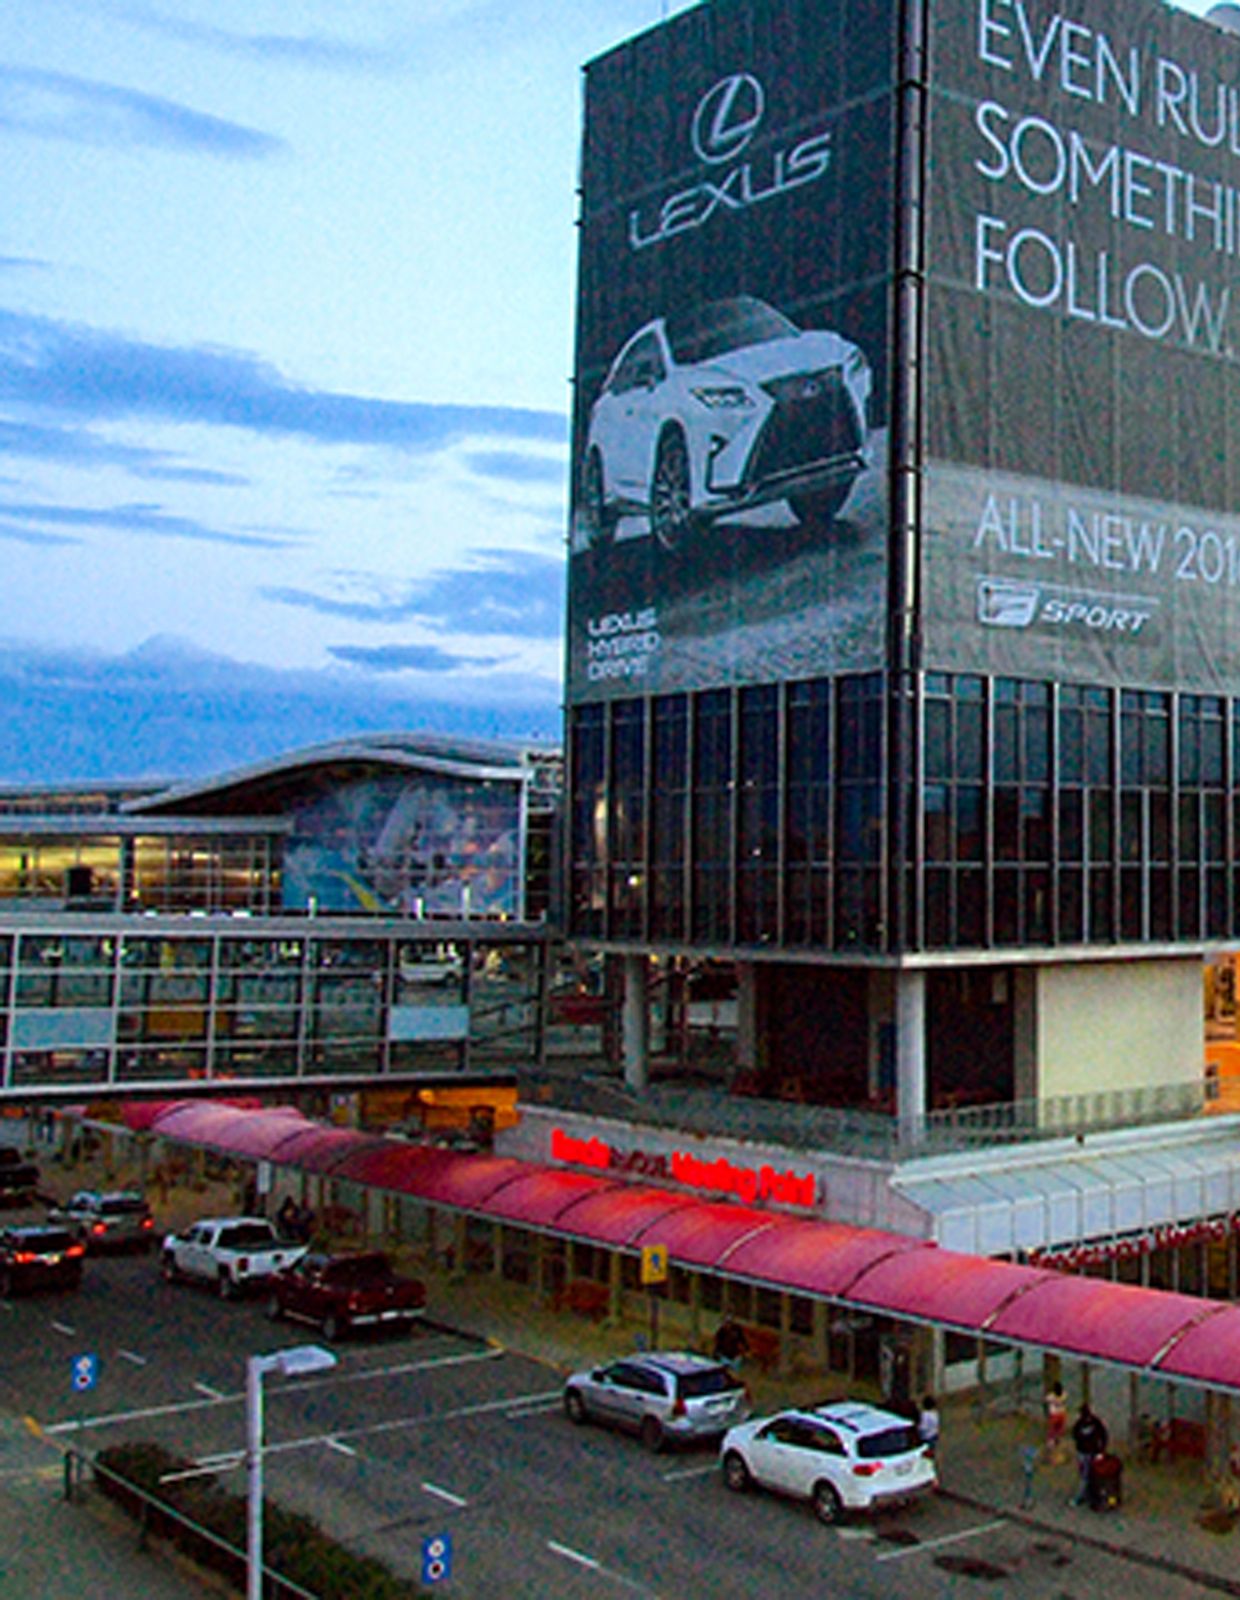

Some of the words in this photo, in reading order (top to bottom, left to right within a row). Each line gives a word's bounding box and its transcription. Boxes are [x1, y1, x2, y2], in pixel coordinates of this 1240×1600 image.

[979, 0, 1139, 116] EVEN
[629, 132, 831, 249] LEXUS
[976, 215, 1235, 358] FOLLOW.
[974, 494, 1166, 573] ALL-NEW
[1041, 599, 1150, 631] SPORT
